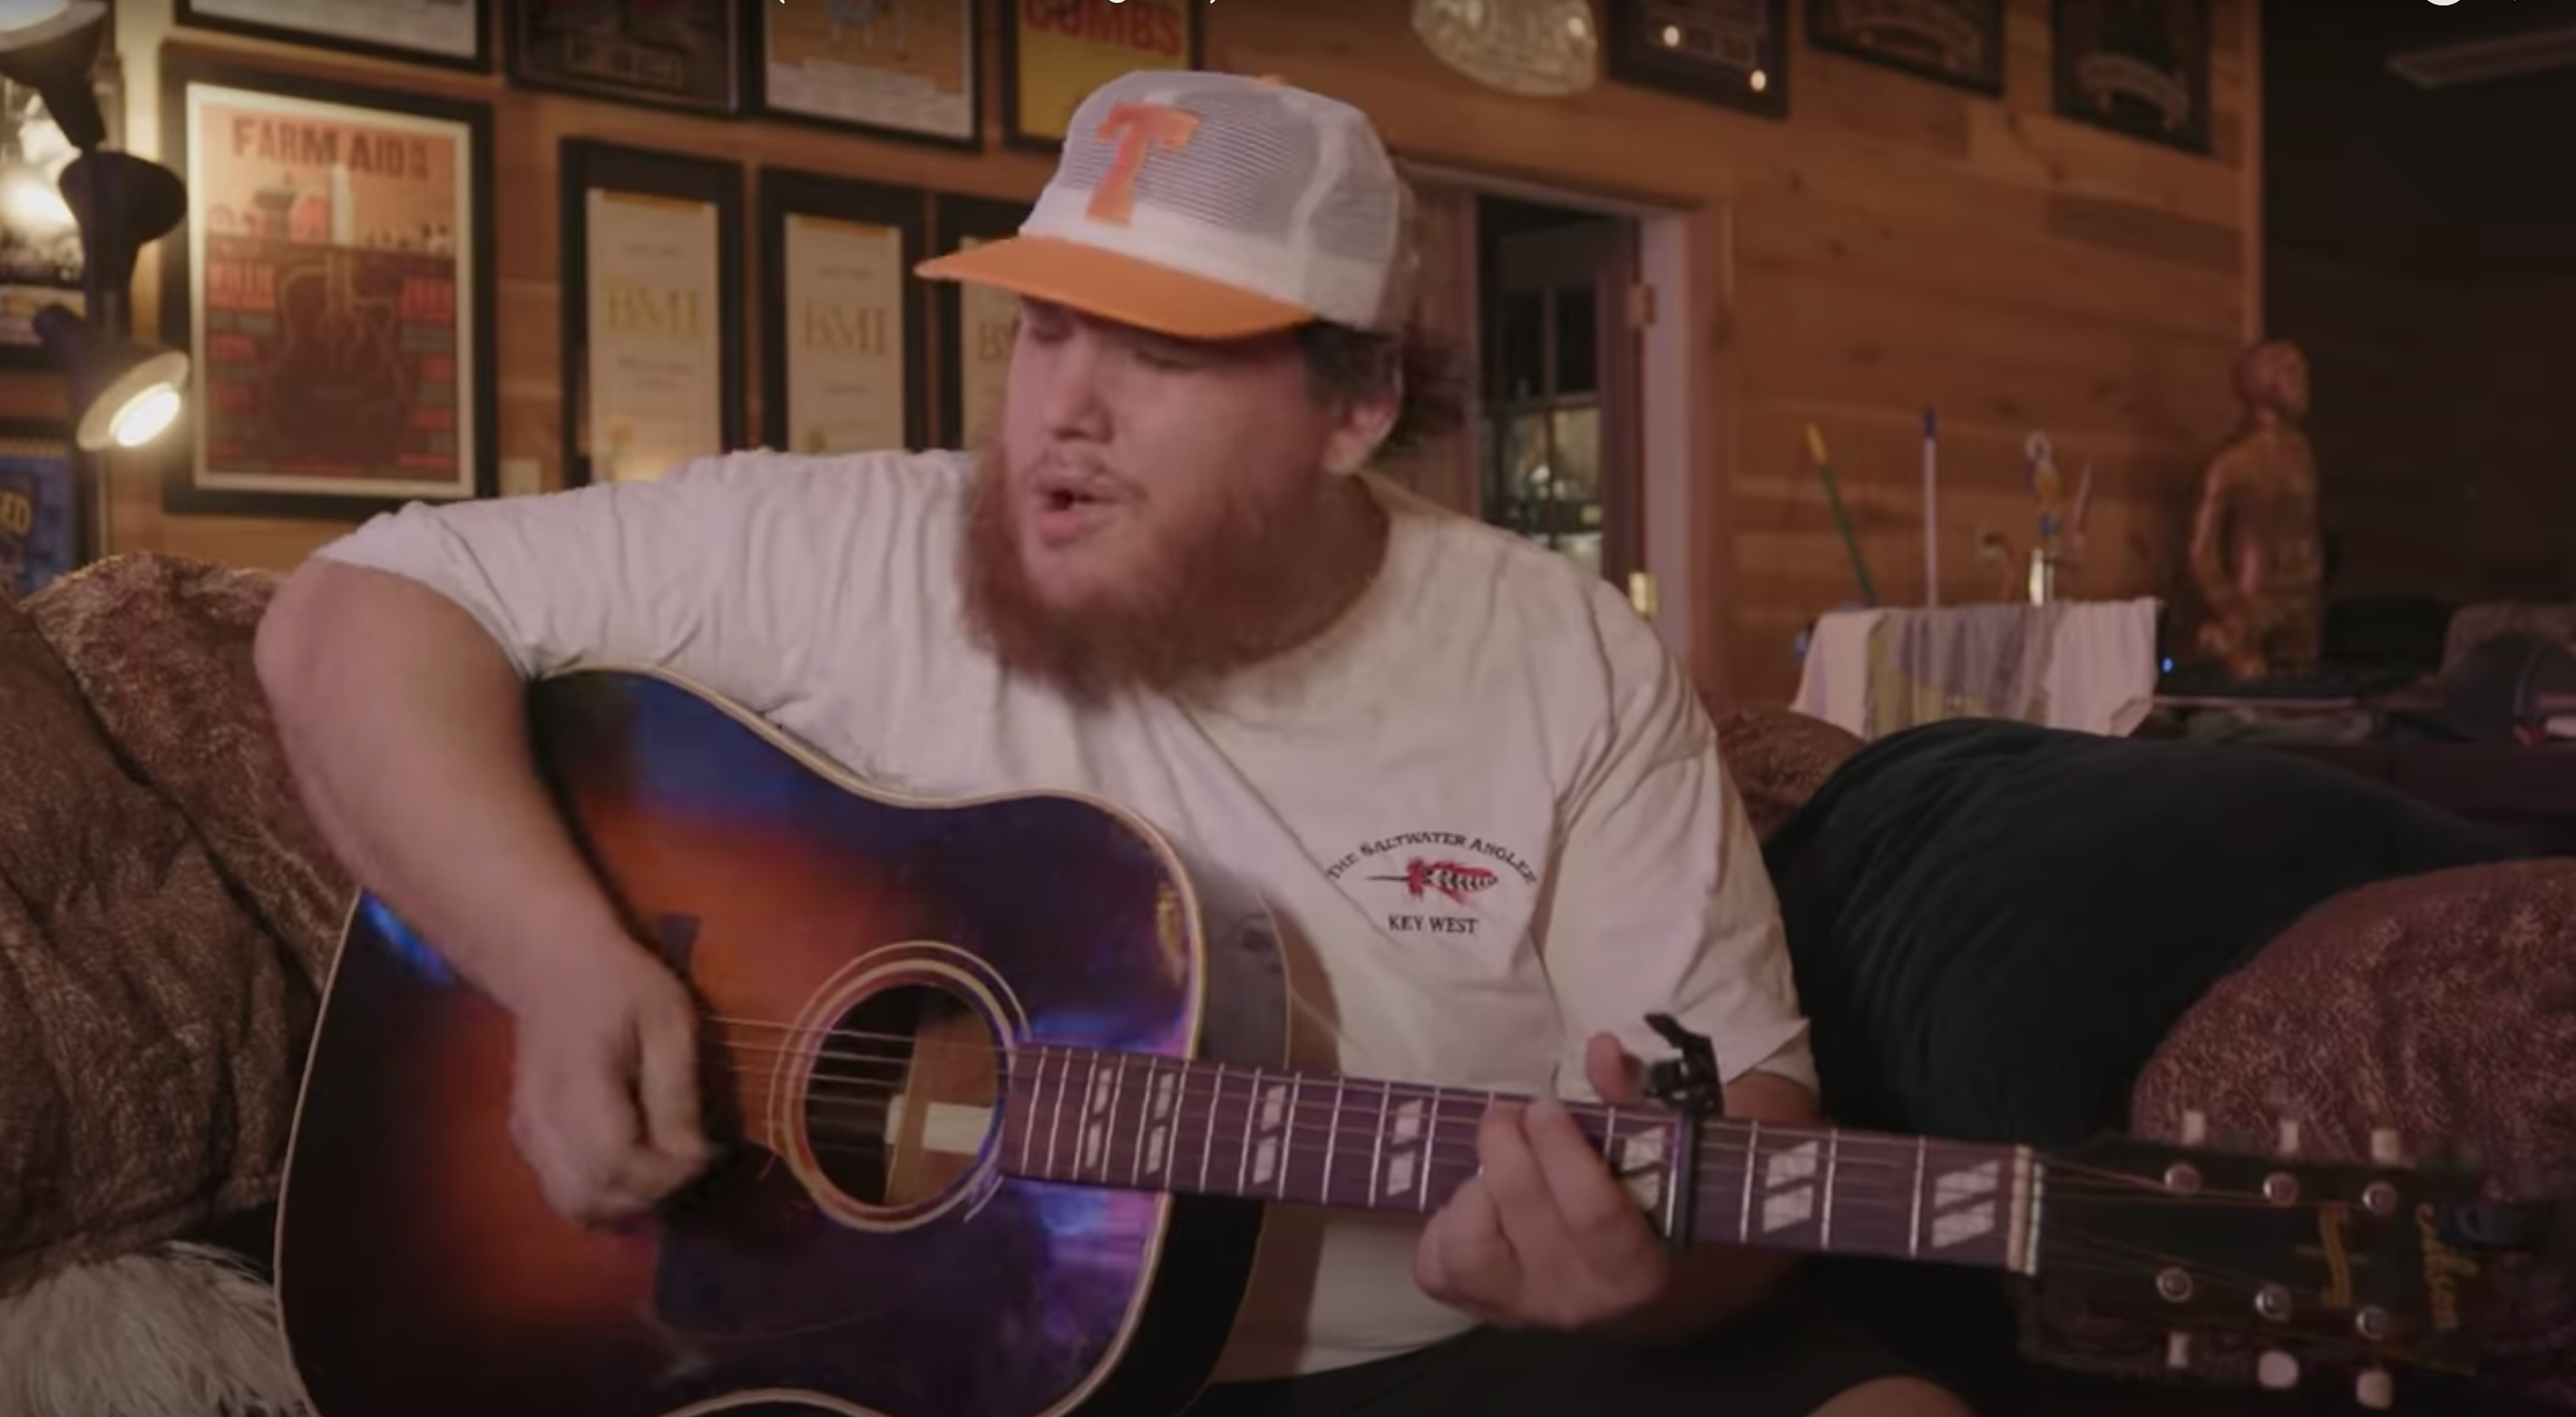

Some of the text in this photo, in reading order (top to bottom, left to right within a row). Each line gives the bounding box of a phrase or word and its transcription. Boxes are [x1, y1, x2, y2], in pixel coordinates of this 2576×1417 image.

[232, 117, 339, 166] FARM
[1086, 101, 1203, 229] T
[606, 285, 700, 341] BMI
[803, 296, 888, 357] BMI
[1325, 851, 1361, 880] THE
[1360, 830, 1467, 856] SALTWATER
[1388, 914, 1479, 935] KEY WEST
